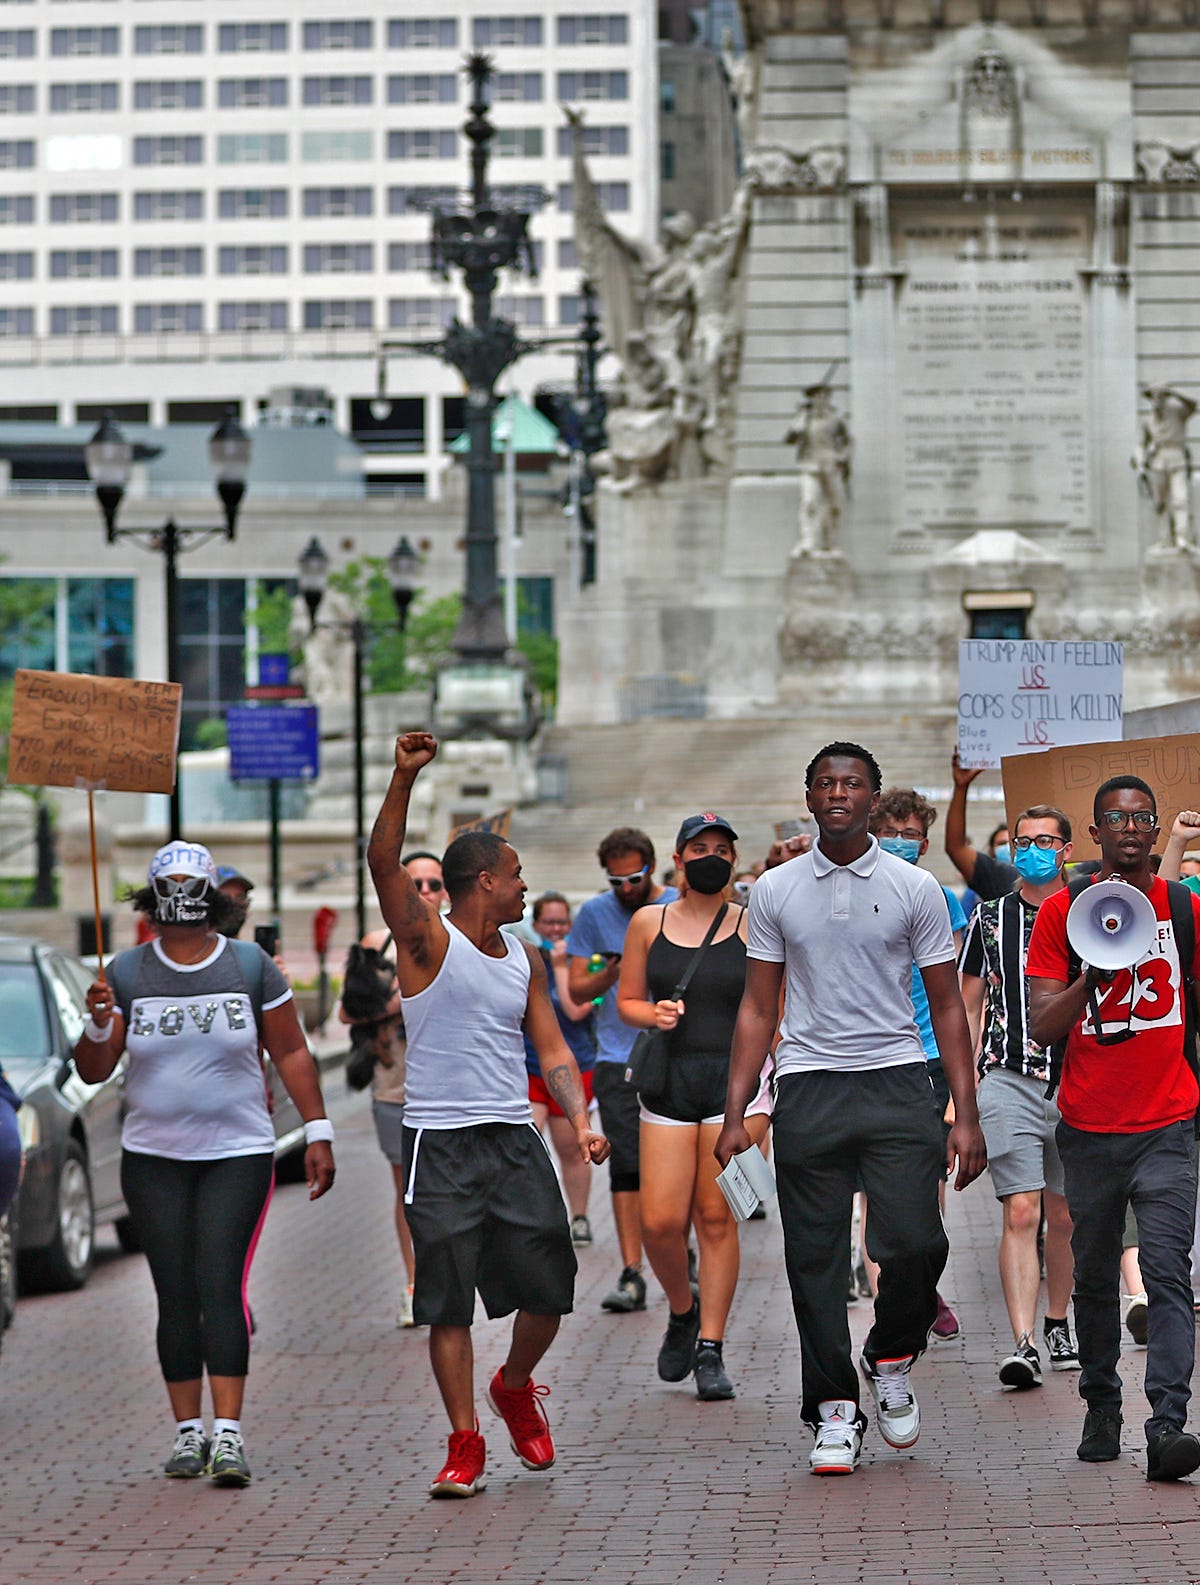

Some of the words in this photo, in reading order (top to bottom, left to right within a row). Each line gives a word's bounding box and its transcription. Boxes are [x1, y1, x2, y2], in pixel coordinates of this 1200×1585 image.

[961, 641, 1016, 663] TRUMP
[1021, 664, 1046, 688] US
[958, 693, 1005, 719] COPS
[1011, 693, 1066, 721] STILL
[958, 725, 988, 738] Blue
[1023, 720, 1049, 745] US
[132, 1000, 247, 1036] LOVE
